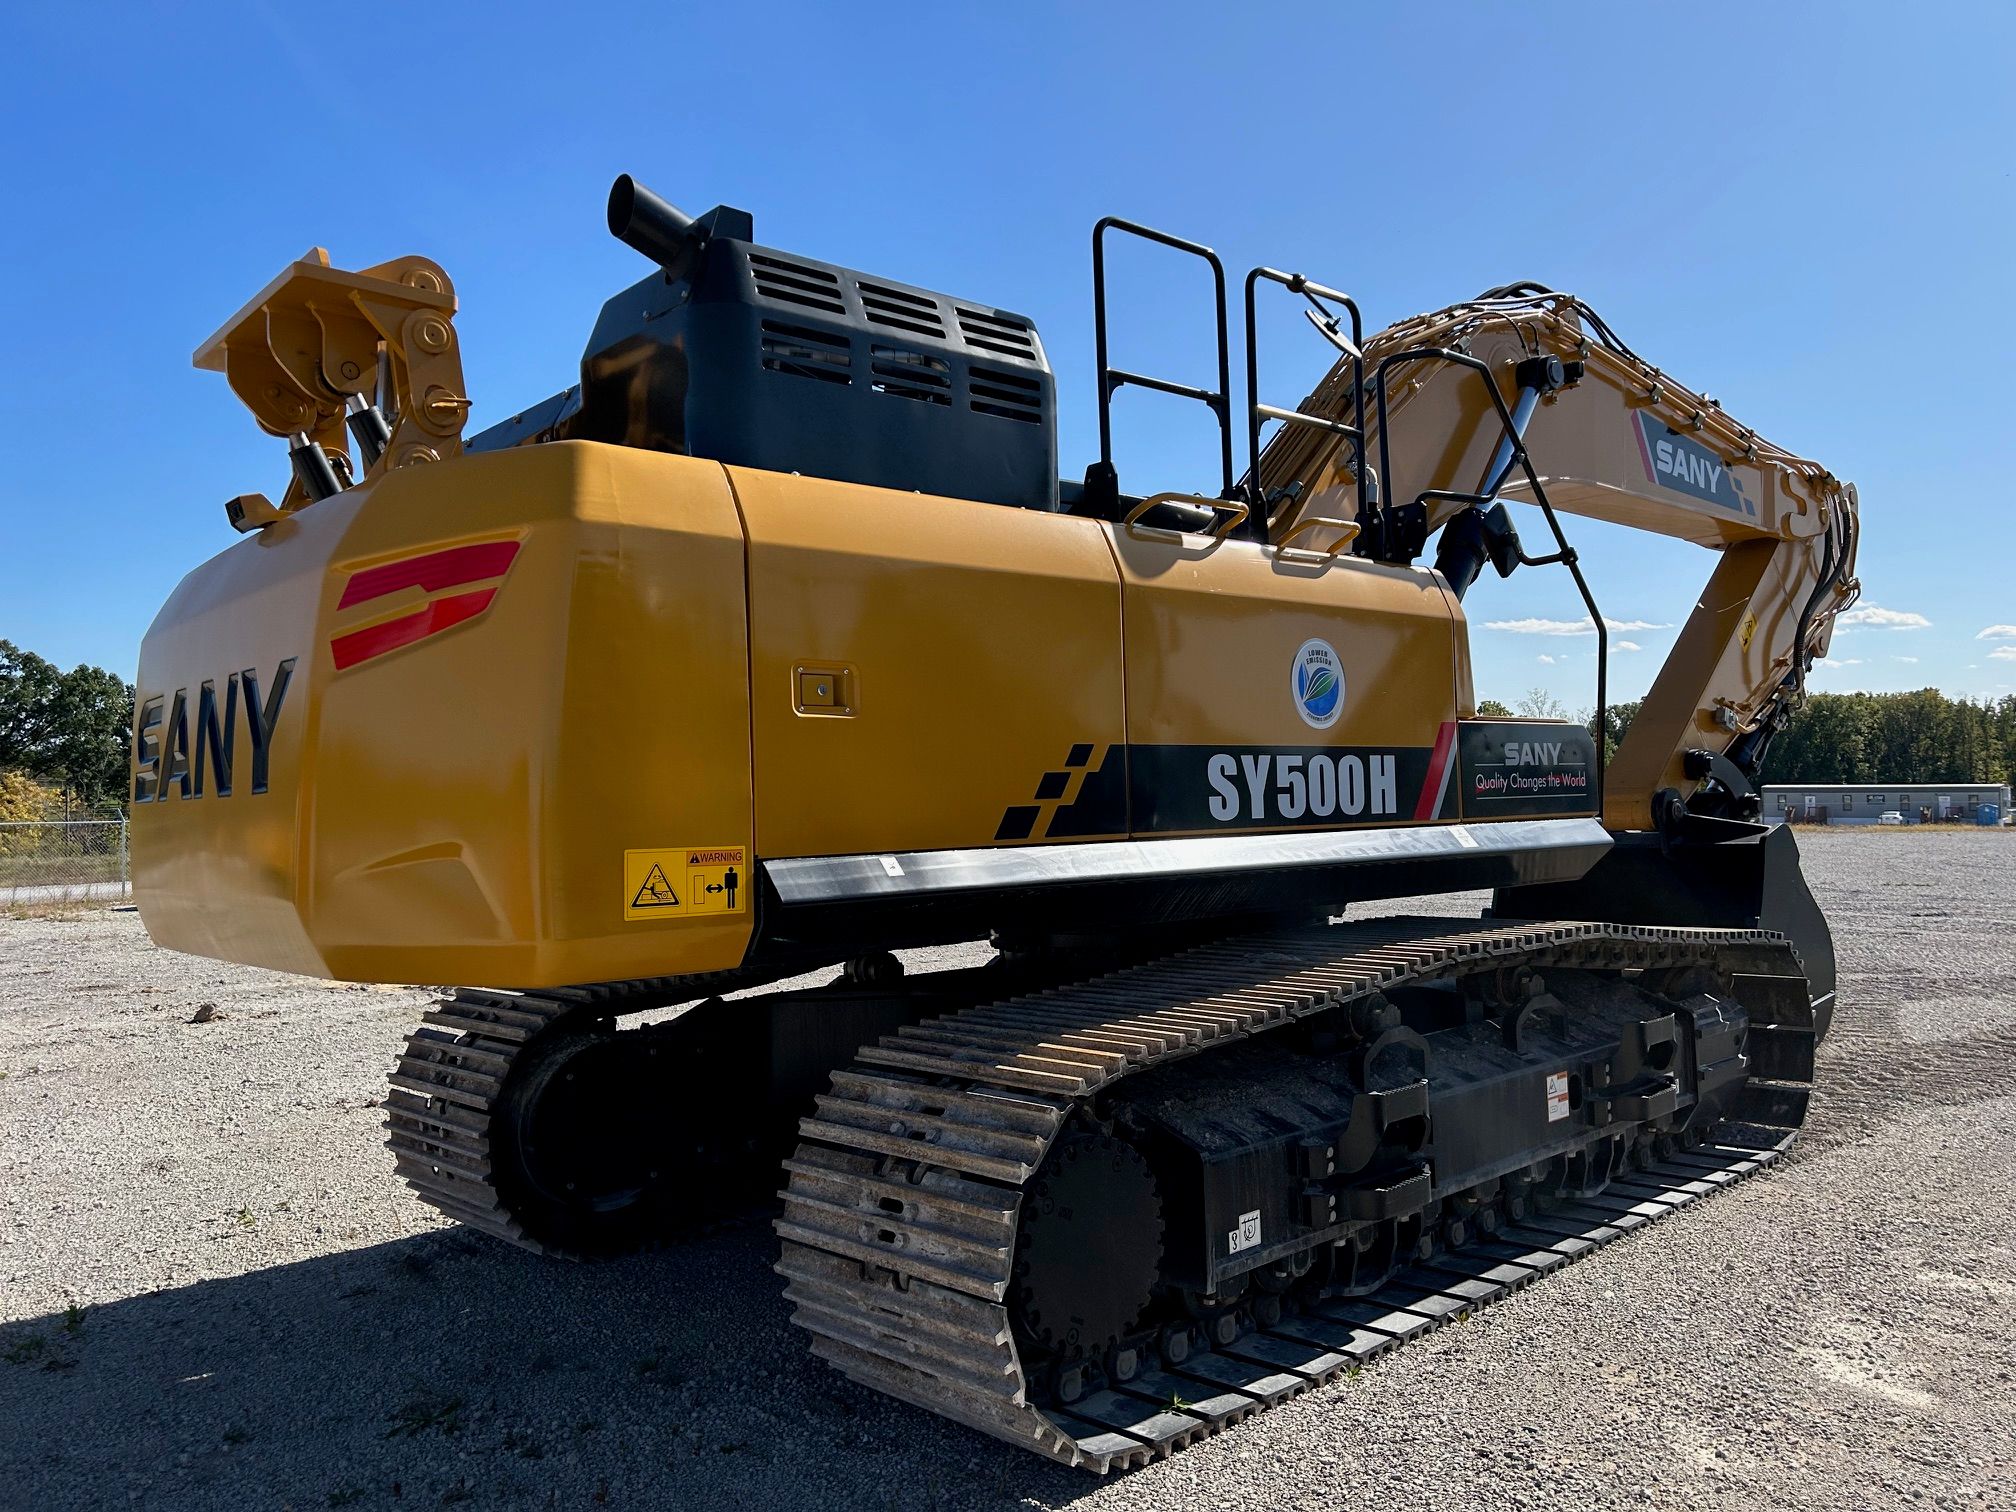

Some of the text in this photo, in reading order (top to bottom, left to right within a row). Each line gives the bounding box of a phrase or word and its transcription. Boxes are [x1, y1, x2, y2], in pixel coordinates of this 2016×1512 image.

[1656, 439, 1722, 494] SANY
[1306, 656, 1332, 666] EMISSION
[1308, 649, 1328, 657] LOWER
[134, 656, 299, 803] SANY
[1504, 742, 1562, 766] SANY
[1207, 753, 1397, 822] SY500H
[1476, 770, 1586, 793] Quality Changes the World
[700, 851, 743, 863] WARNING
